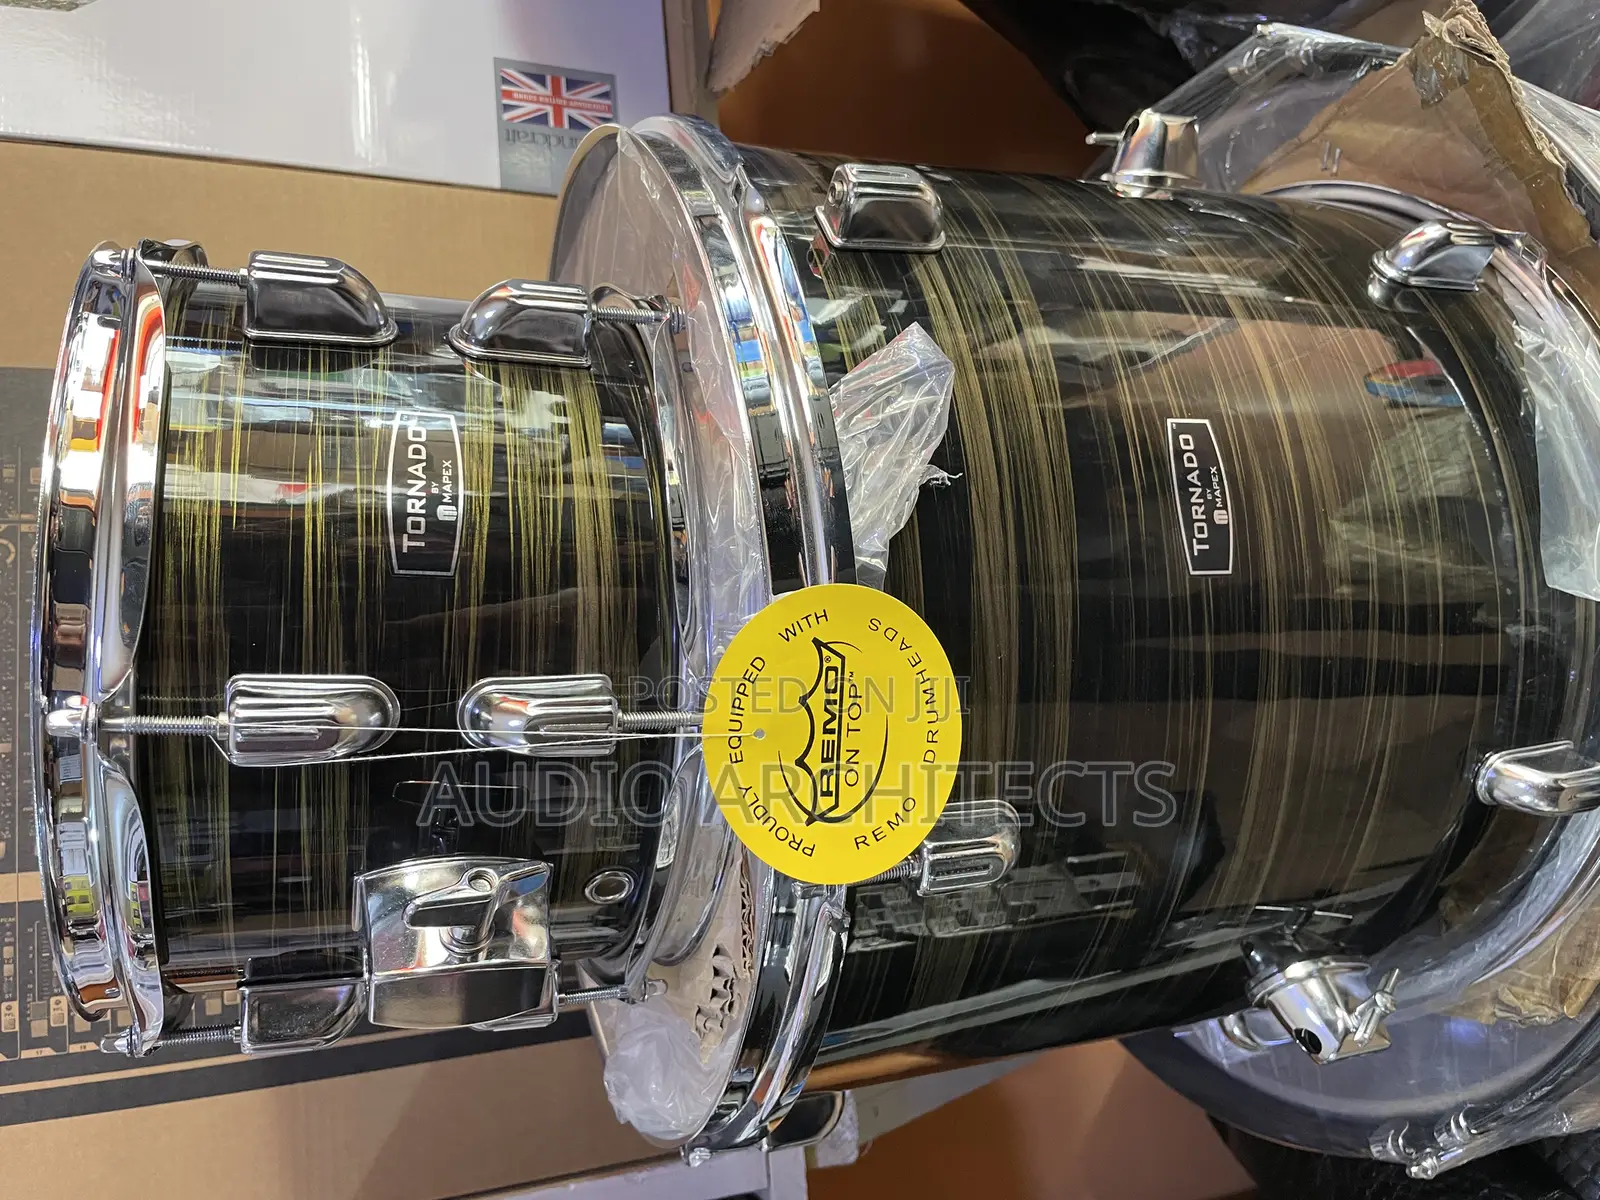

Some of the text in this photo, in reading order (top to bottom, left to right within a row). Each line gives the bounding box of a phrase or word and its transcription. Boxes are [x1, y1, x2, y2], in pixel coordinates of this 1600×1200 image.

[402, 425, 427, 553] TORNADO
[431, 481, 440, 494] BY
[442, 459, 452, 503] MAPEX
[1178, 433, 1210, 556] TORNADO
[1206, 488, 1213, 500] BY
[1209, 466, 1223, 508] MAPEX
[727, 608, 829, 858] PROUDLY EQUIPPED WITH
[853, 616, 940, 851] REMO DRUMHEADS
[845, 748, 861, 787] ON
